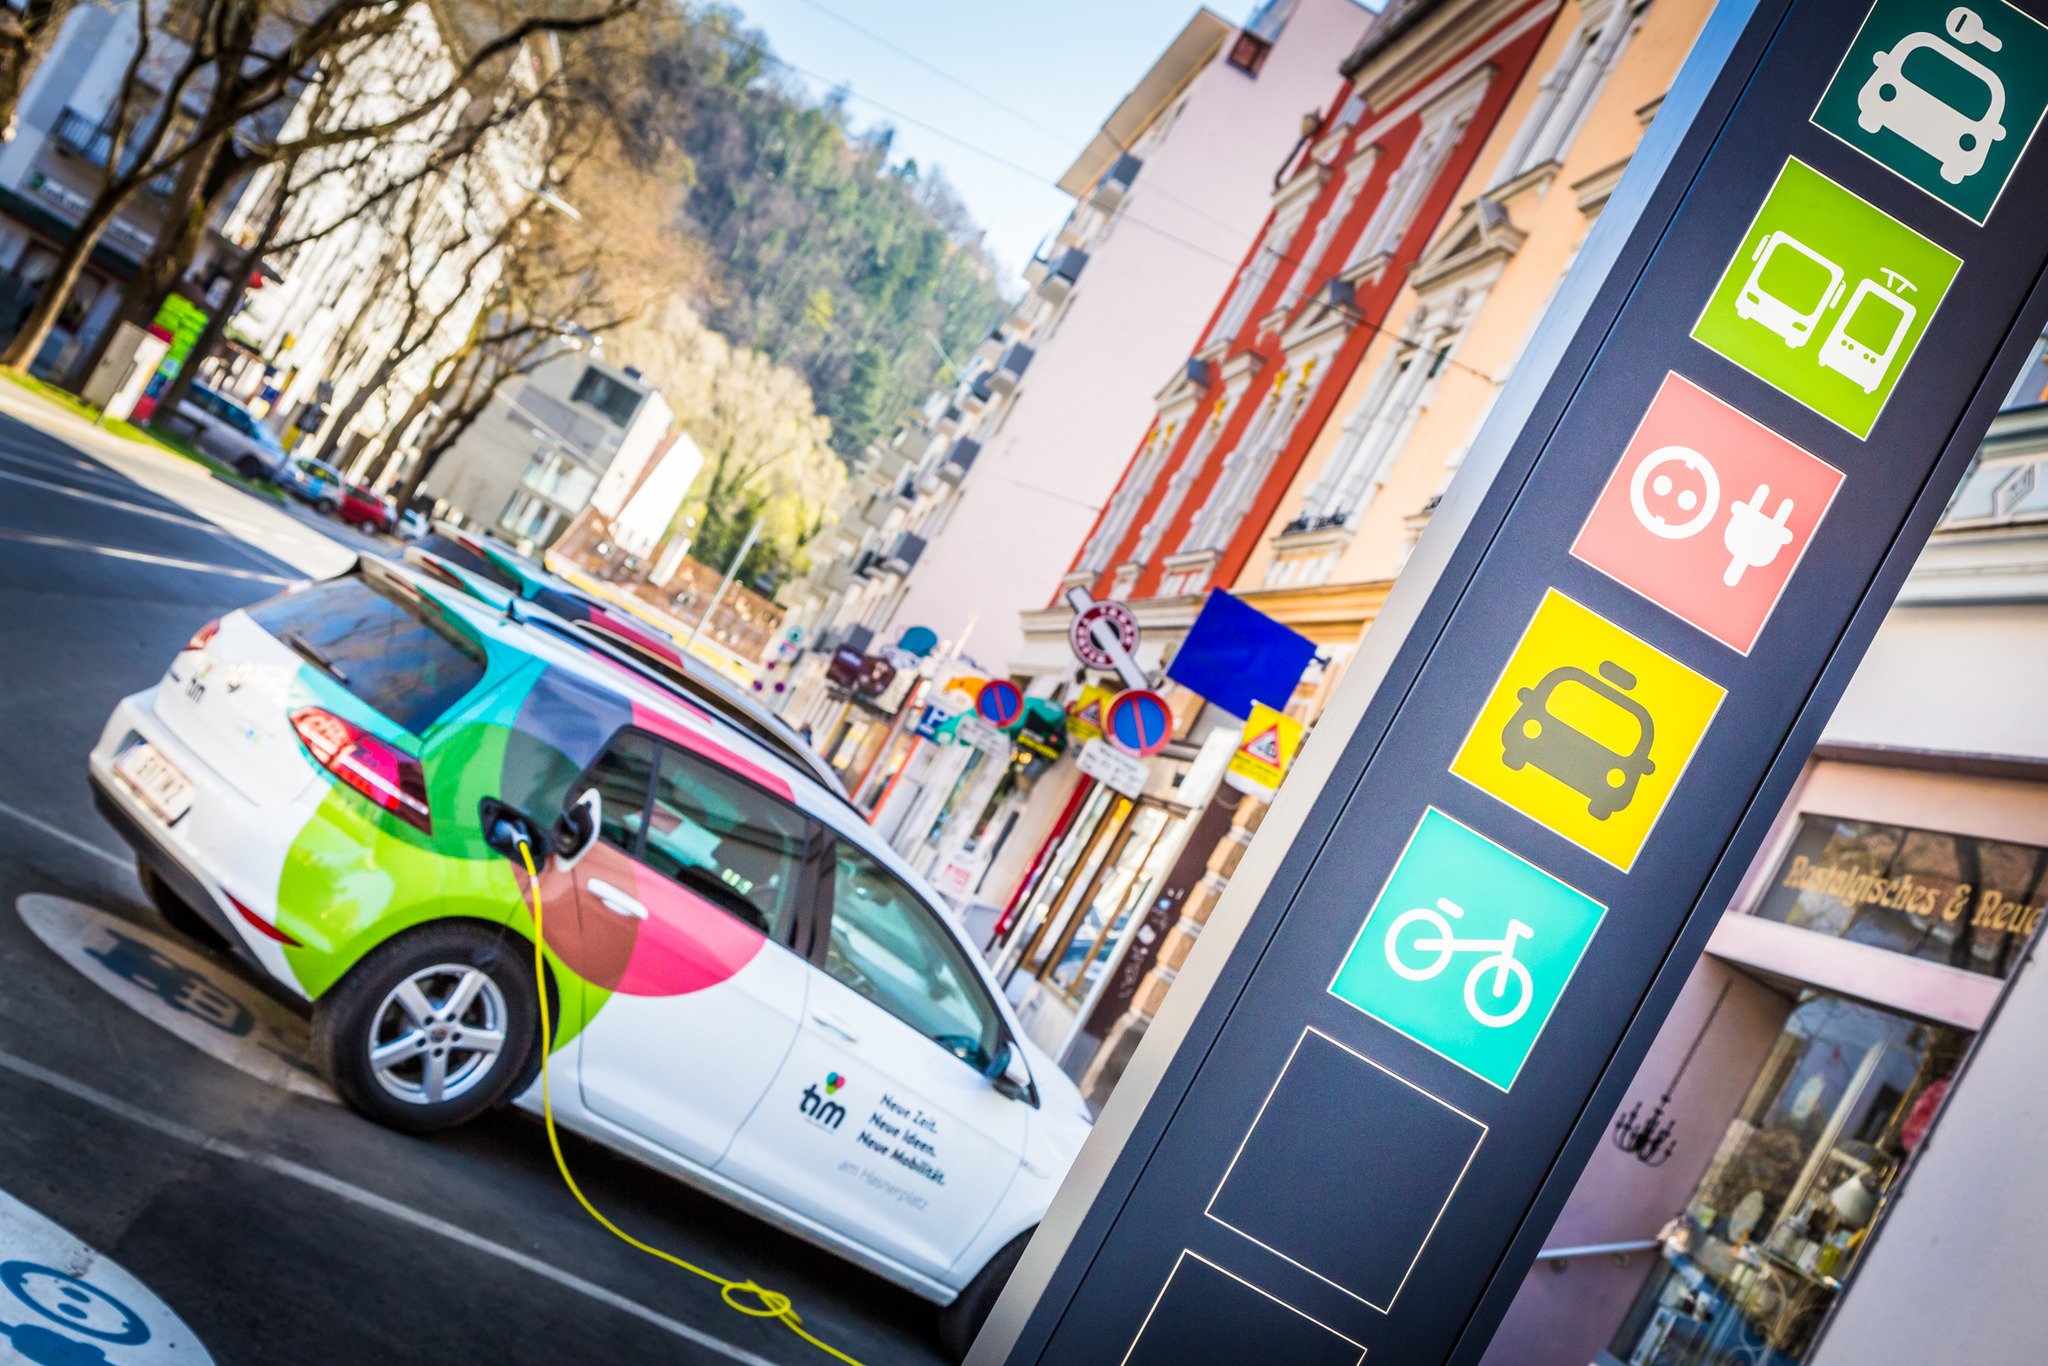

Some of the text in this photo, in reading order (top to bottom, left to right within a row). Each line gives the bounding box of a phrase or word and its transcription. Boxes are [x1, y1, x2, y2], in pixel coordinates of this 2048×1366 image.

[1941, 883, 1972, 923] &
[798, 1073, 846, 1131] tim
[880, 1093, 938, 1135] Neue Zeit.
[857, 1130, 945, 1186] Neue Mobilität.
[869, 1111, 937, 1158] Neue Ideen.
